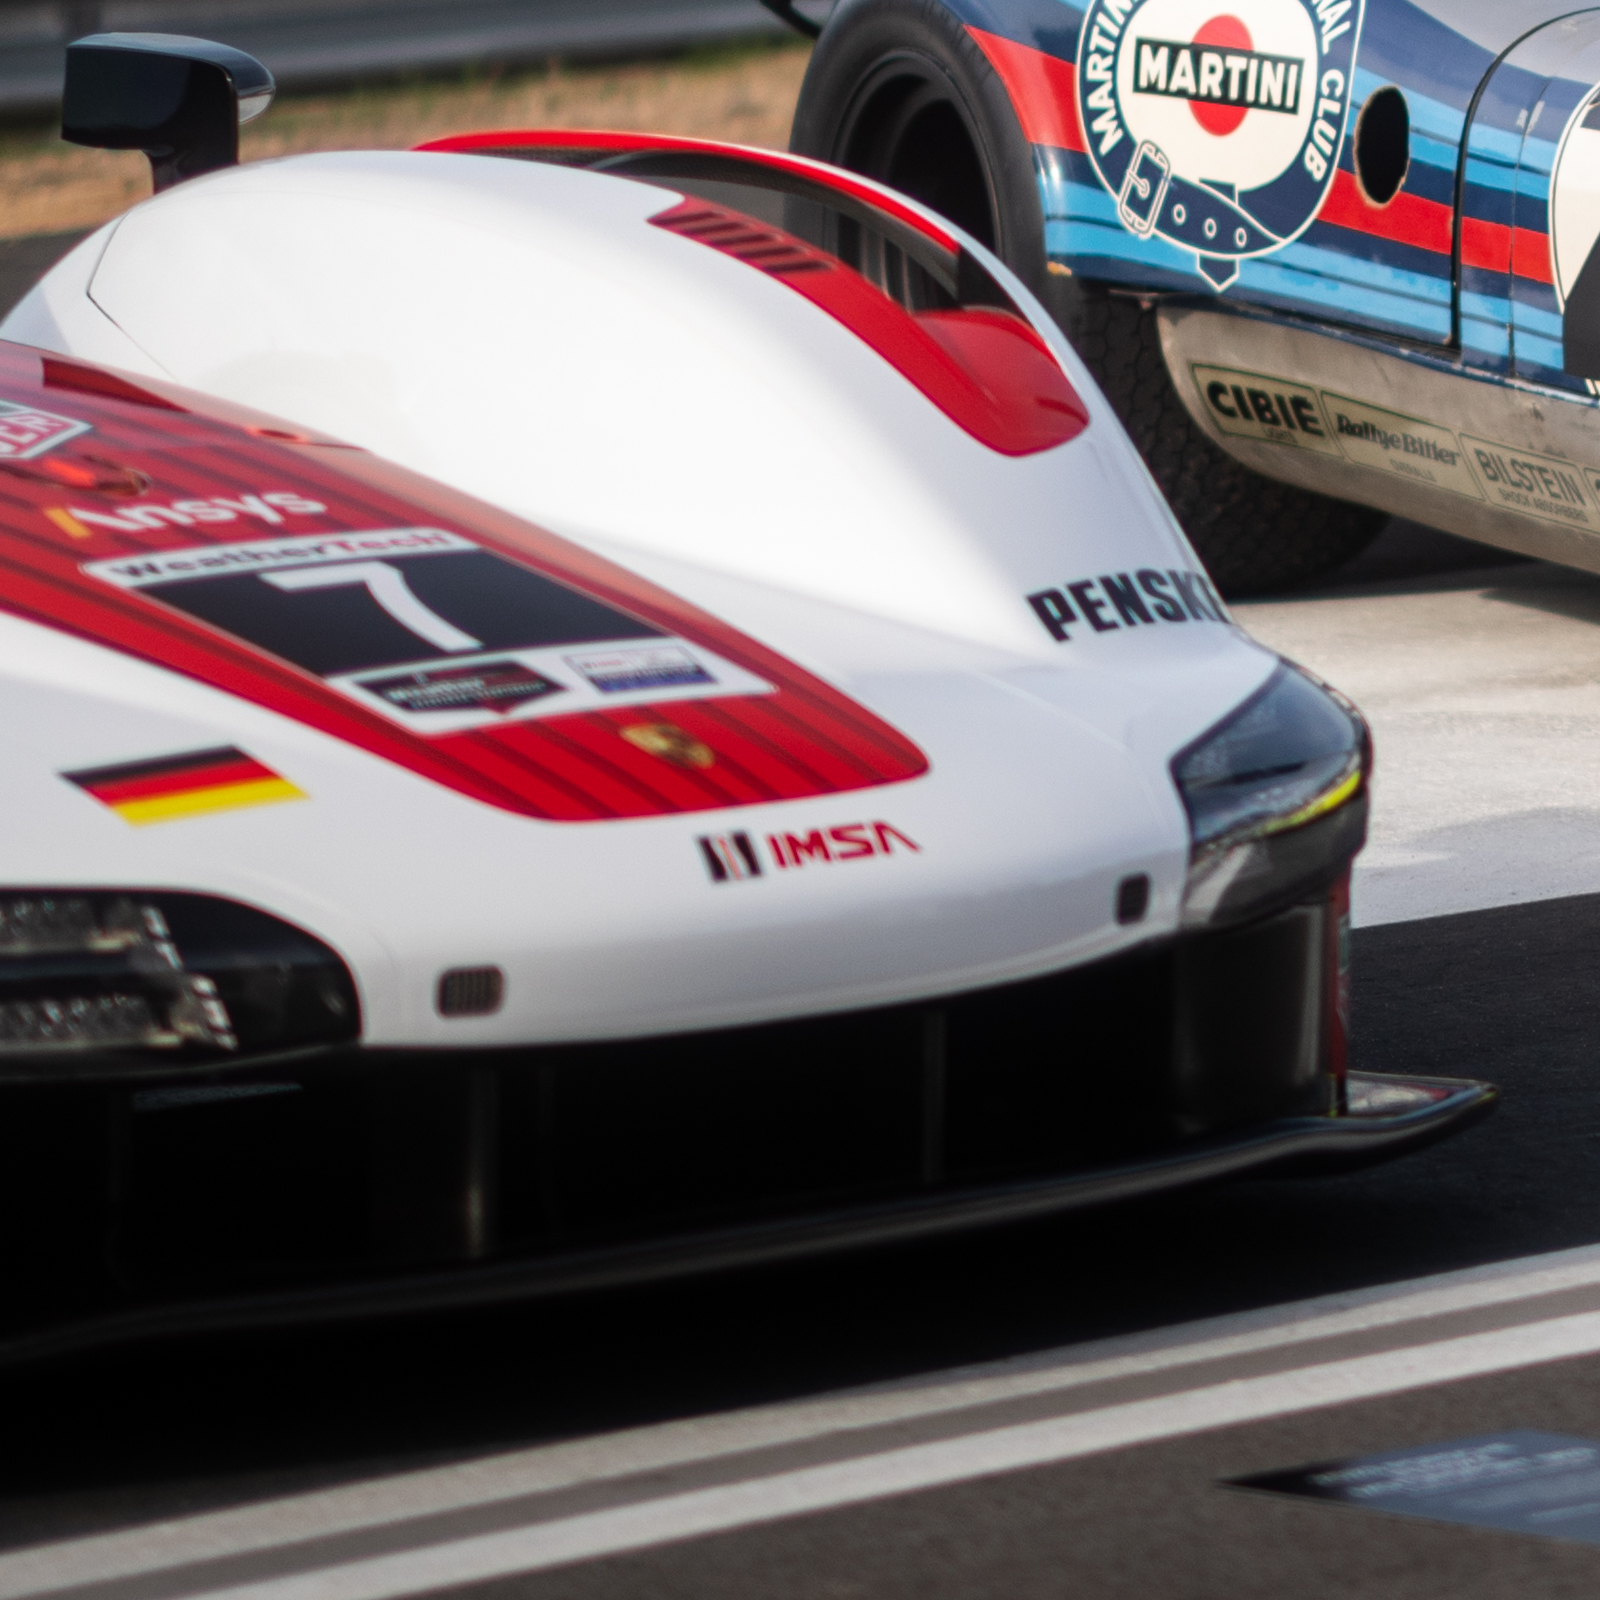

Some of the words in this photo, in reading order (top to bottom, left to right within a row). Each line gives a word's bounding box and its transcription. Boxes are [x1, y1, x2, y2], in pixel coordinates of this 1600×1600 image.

[1138, 43, 1299, 110] MARTINI
[1303, 68, 1345, 182] CLUB
[1207, 381, 1325, 438] CIBIE
[1474, 447, 1586, 506] BILSTEIN
[110, 533, 448, 578] WeatherTech
[258, 560, 483, 652] 7
[1026, 568, 1232, 642] PENSK
[767, 820, 920, 868] IMSA
